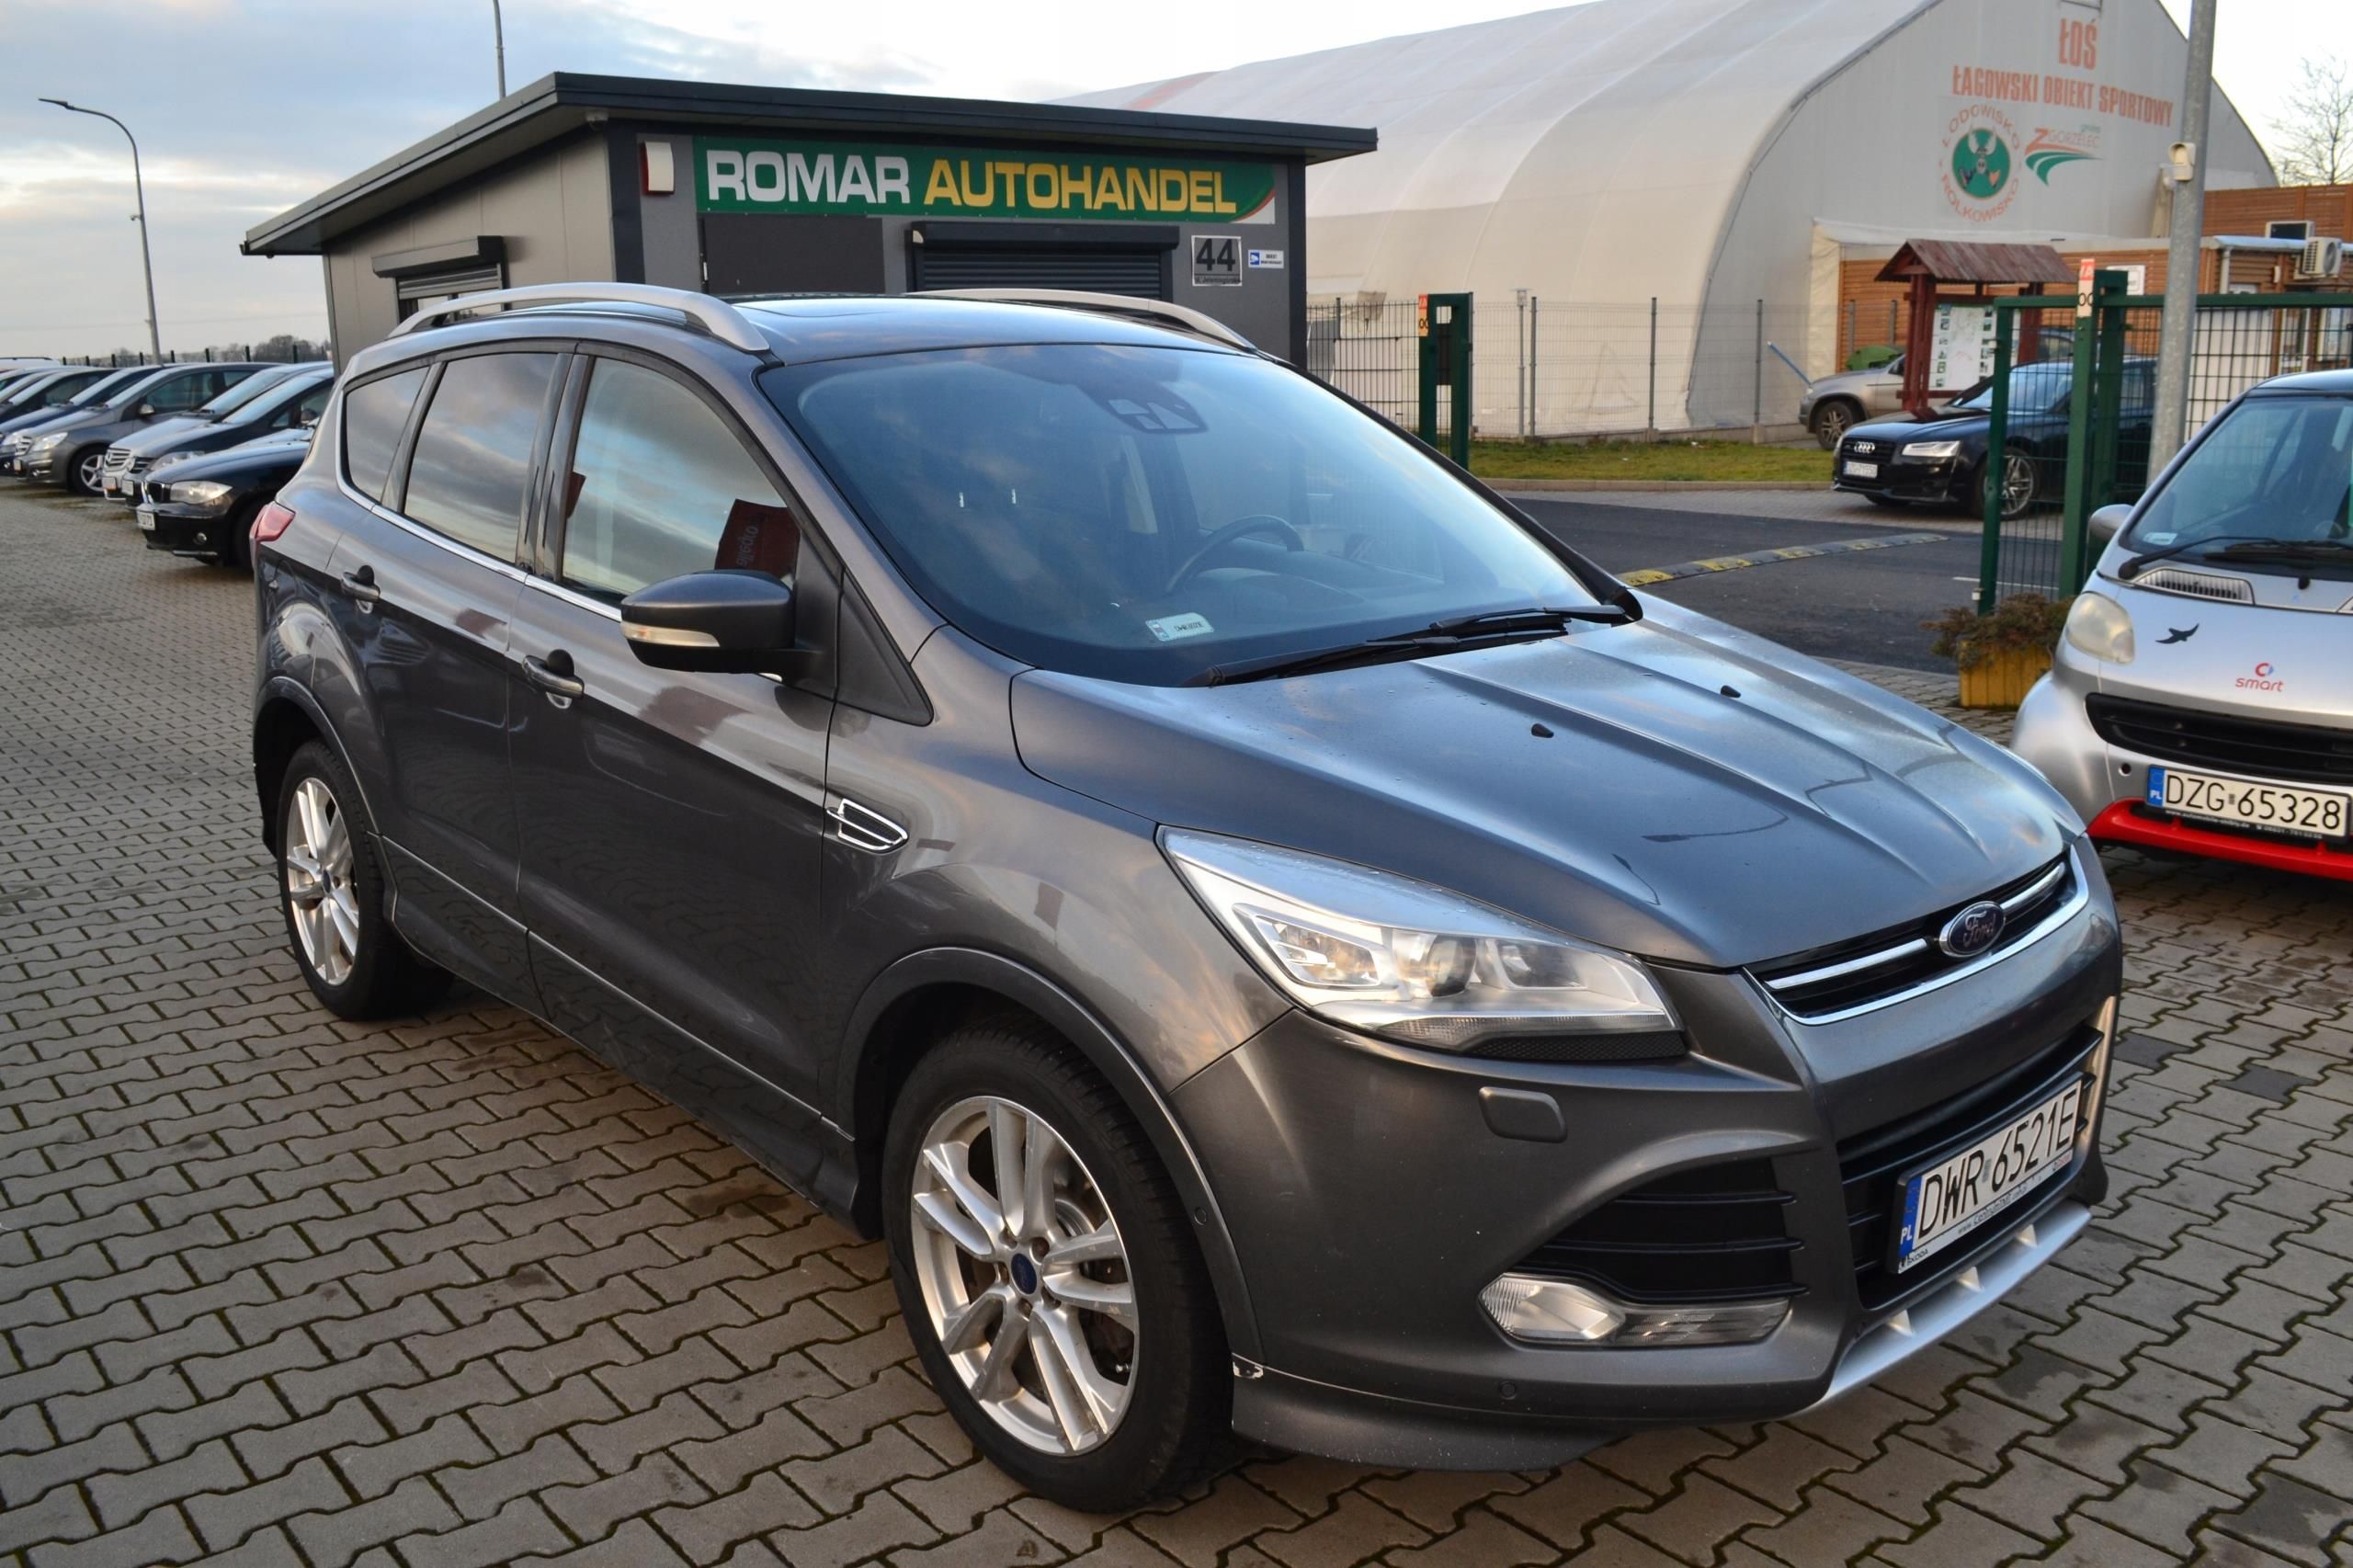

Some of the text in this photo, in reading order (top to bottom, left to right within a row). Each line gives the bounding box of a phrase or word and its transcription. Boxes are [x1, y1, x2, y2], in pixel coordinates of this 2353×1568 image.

[2059, 18, 2098, 70] ŁOŚ
[1952, 65, 2174, 127] ŁAGOWSKI OBIEKT SPORTOWY
[706, 149, 1236, 214] ROMAR AUTOHANDEL
[1196, 238, 1236, 271] 44
[2235, 677, 2285, 692] smart
[2150, 790, 2163, 801] PL
[2165, 775, 2225, 812] DZG
[2237, 788, 2341, 830] 65328
[1918, 1150, 1984, 1239] DWR
[1993, 1090, 2077, 1192] 6521E
[1900, 1225, 1913, 1244] PL
